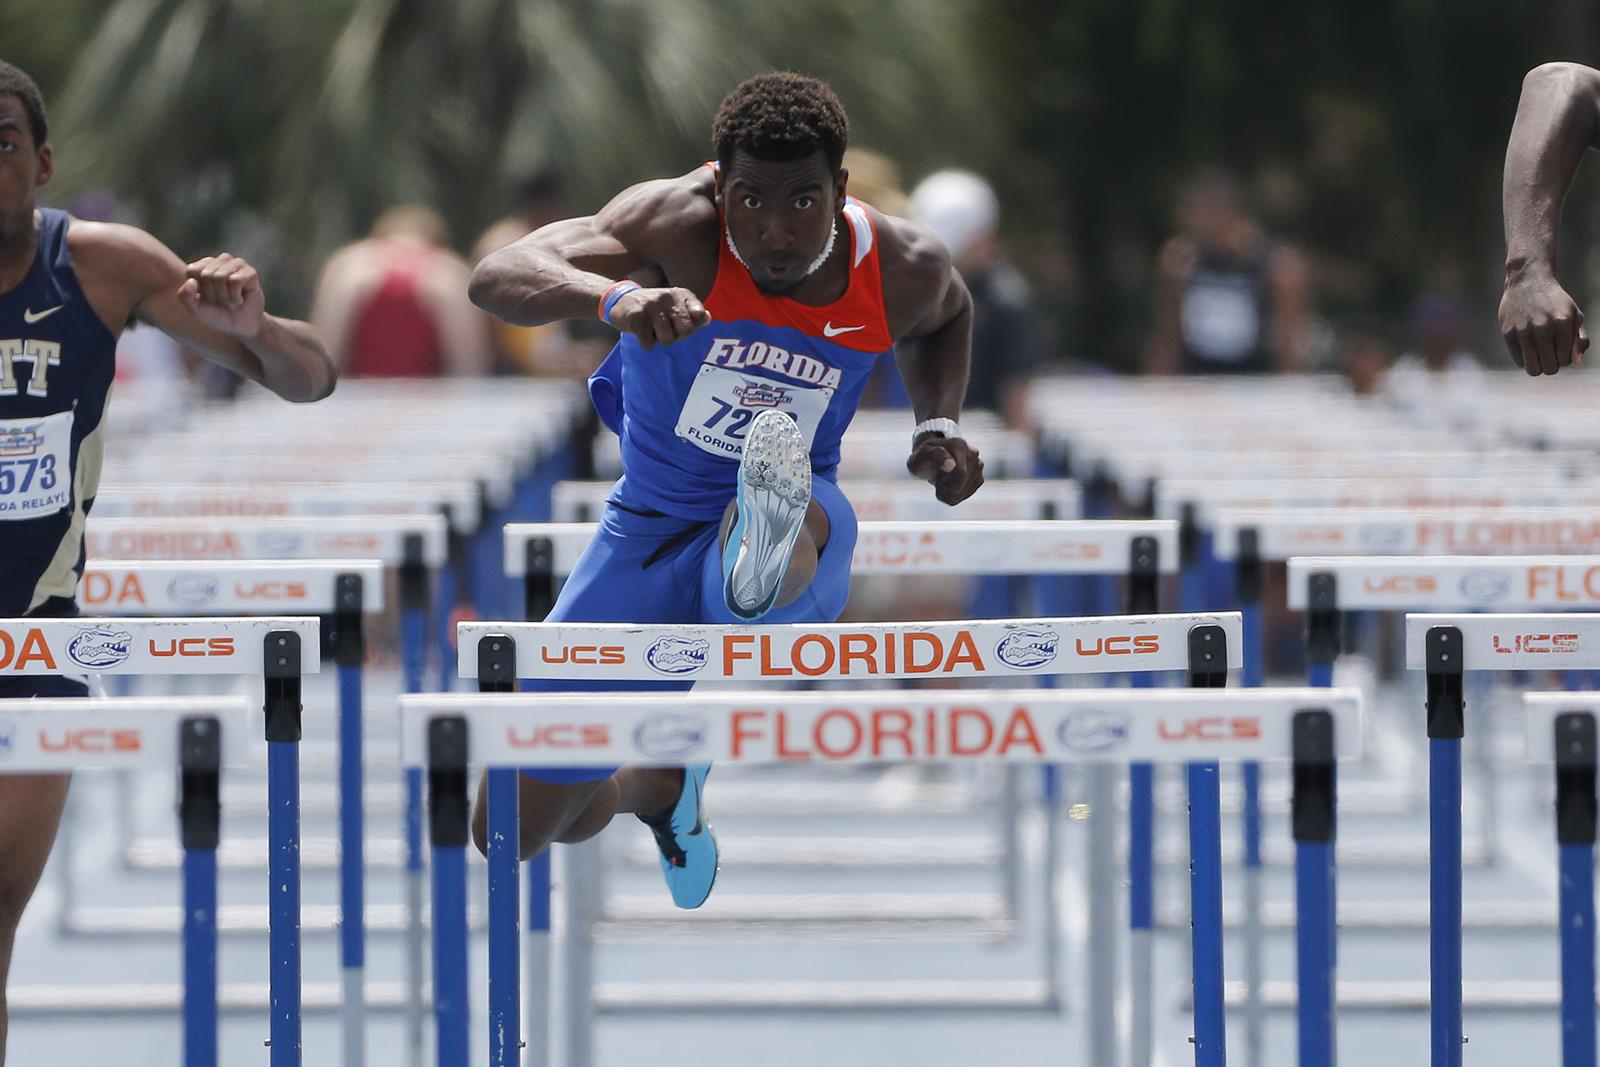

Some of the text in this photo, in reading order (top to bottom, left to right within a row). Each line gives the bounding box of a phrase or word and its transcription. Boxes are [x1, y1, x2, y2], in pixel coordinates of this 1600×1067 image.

[704, 338, 842, 389] FLORIDA
[703, 396, 799, 440] 72
[688, 427, 743, 455] FLORIDA
[234, 582, 308, 600] UCS
[149, 637, 235, 657] UCS
[541, 630, 1160, 677] UCS FLORIDA UCS
[1493, 634, 1580, 654] UCS
[38, 728, 141, 752] UCS
[506, 706, 1261, 761] UCS FLORIDA UCS
